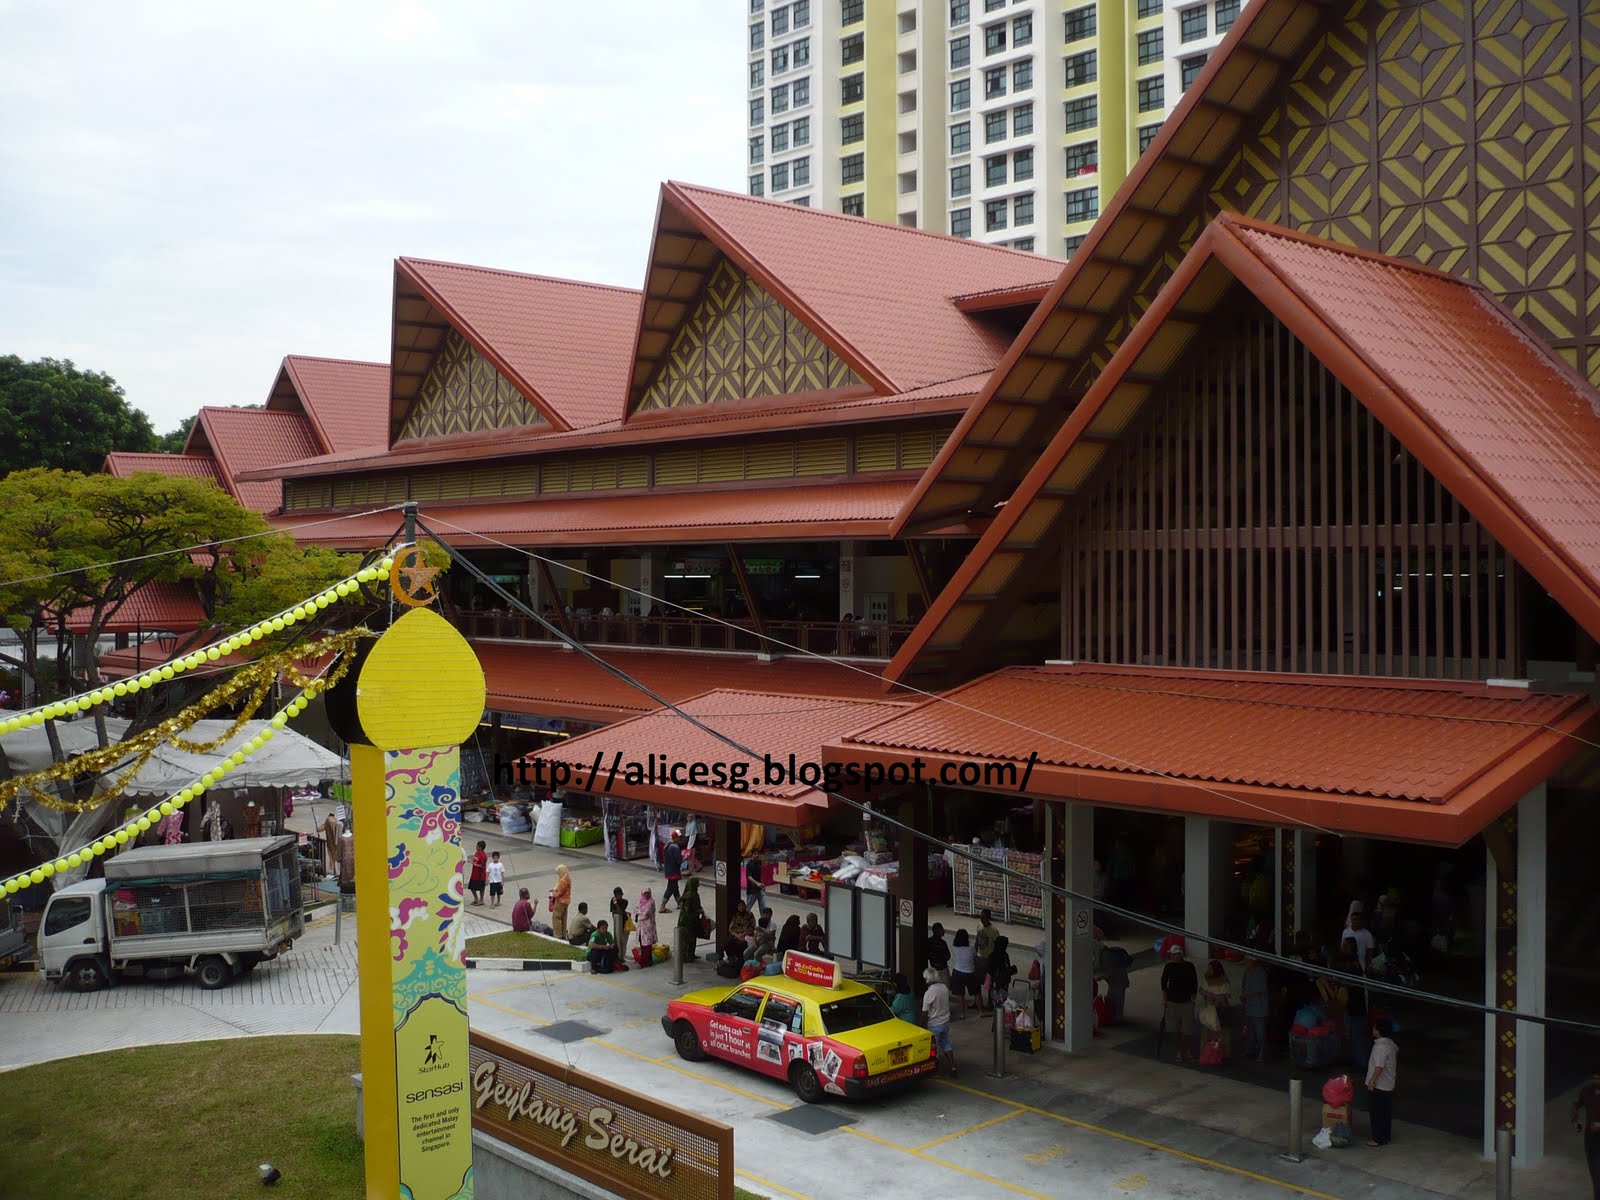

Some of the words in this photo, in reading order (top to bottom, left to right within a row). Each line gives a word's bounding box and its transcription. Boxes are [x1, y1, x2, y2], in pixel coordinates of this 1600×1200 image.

[710, 1020, 719, 1029] Get
[719, 1024, 731, 1033] extra
[731, 1028, 743, 1036] cash
[715, 1031, 724, 1040] just
[724, 1032, 728, 1042] 1
[729, 1033, 744, 1047] hour
[745, 1042, 751, 1050] at
[717, 1042, 730, 1052] OCBC
[730, 1045, 752, 1059] branches
[418, 1062, 450, 1075] StarHub
[913, 1066, 920, 1074] to
[406, 1080, 464, 1104] sensasi
[436, 1109, 447, 1117] and
[448, 1106, 460, 1114] only
[473, 1061, 578, 1147] Geylang
[585, 1107, 672, 1178] Serai
[412, 1119, 441, 1131] dedicated
[442, 1115, 459, 1124] Malay
[416, 1123, 456, 1138] entertainment
[421, 1134, 445, 1145] channel
